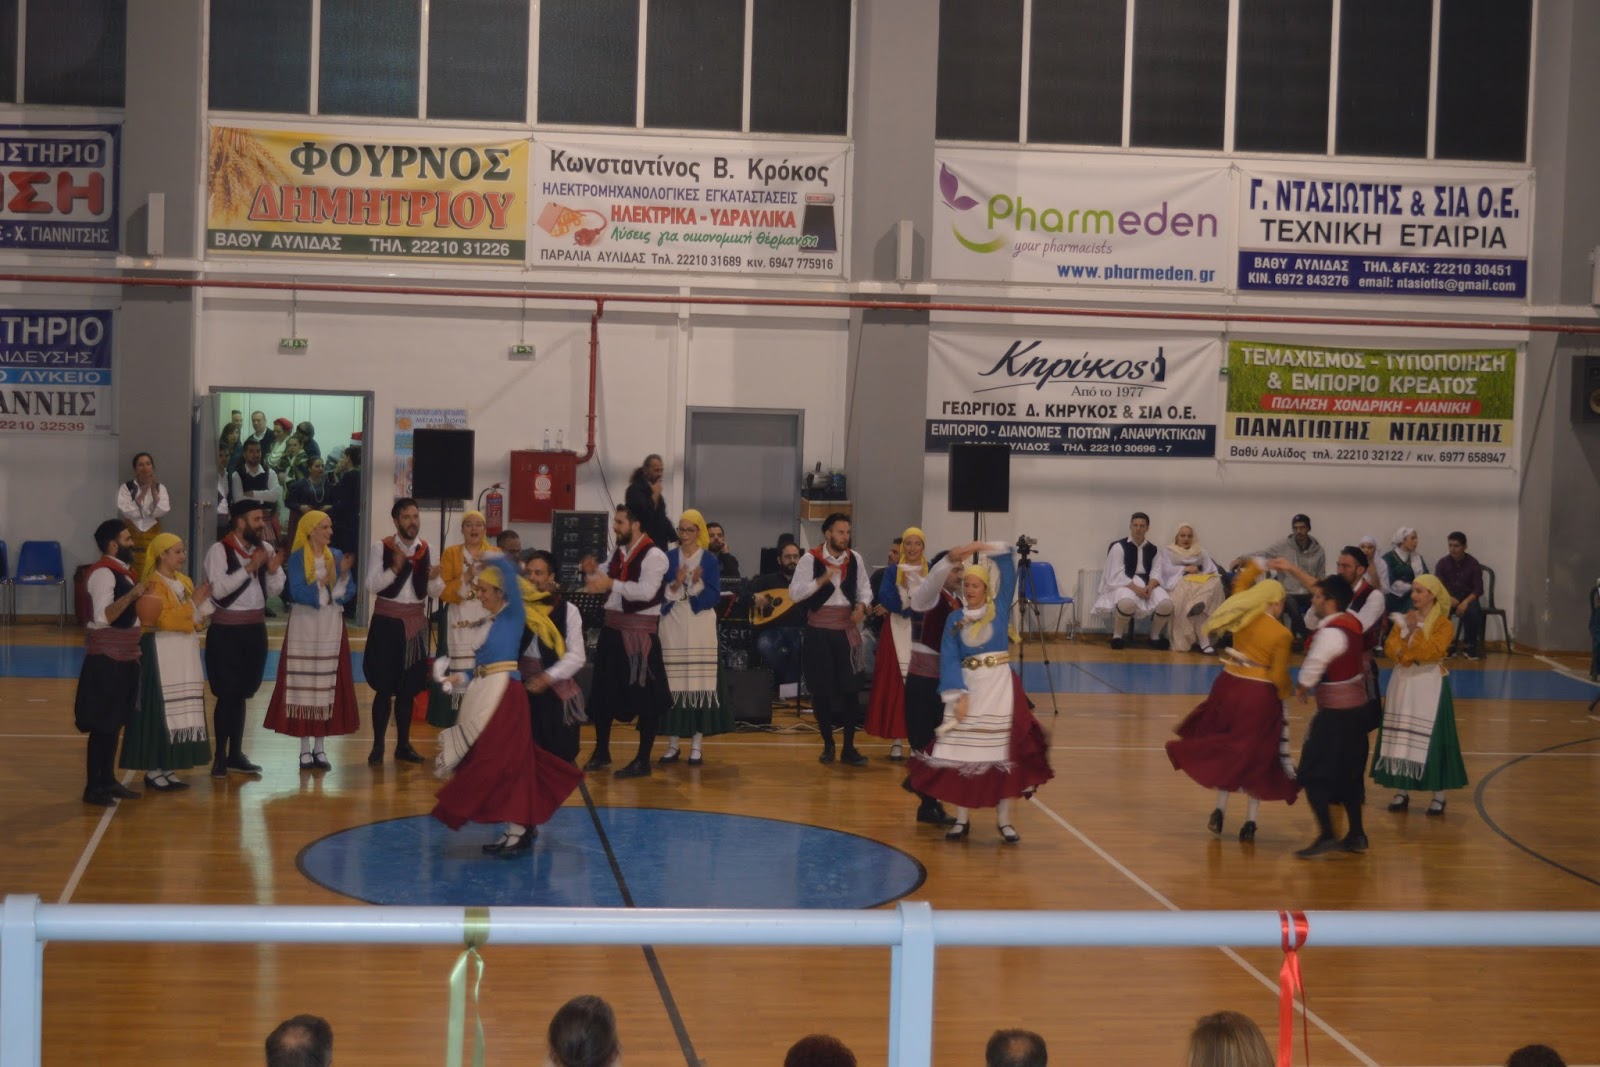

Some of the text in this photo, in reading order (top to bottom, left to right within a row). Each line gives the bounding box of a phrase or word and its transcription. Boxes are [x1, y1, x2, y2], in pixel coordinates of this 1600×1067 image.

[290, 141, 512, 181] ΦΟΥΡΝΟΣ
[550, 149, 829, 186] Κωνσταντίνος Β. Κρόκος
[0, 171, 104, 215] ΣΗ
[542, 182, 700, 201] ΗΛΕΚΤΡΟΜΗΧΑΝΟΛΟΓΙΚΕΣ
[706, 188, 798, 204] ΕΓΚΑΤΑΣΤΑΣΕΙΣ
[1250, 178, 1519, 218] Γ. ΝΤΑΣΙΩΤΗΣ & ΣΙΑ Ο.Ε.
[248, 184, 515, 230] ΔΗΜΗΤΡΙΟΥ
[611, 204, 697, 225] ΗΛΕΚΤΡΙΚΑ
[711, 208, 796, 228] ΥΔΡΑΥΛΙΚΑ
[15, 226, 27, 242] Χ.
[31, 226, 110, 243] ΓΙΑΝΝΙΤΣΗΣ
[215, 232, 510, 256] ΒΑΘΥ ΑΥΛΙΔΑΣ ΤΗΛ. 22210 31226
[610, 226, 651, 244] Λύσεις
[657, 229, 679, 246] για
[683, 230, 752, 252] οικονομική
[1260, 219, 1507, 249] ΤΕΧΝΙΚΗ ΕΤΑΙΡΙΑ
[540, 249, 833, 270] ΠΑΡΑΛΙΑ ΑΥΛΙΔΑΣ Τηλ. 22210 31689 κιν. 6947 775916
[1012, 239, 1112, 258] your pharmacists
[1254, 257, 1288, 269] ΒΑΘΥ
[1294, 259, 1349, 272] ΑΥΛΙΔΑΣ
[1433, 263, 1471, 275] 22210
[1474, 264, 1512, 276] 30451
[1248, 272, 1516, 292] ΚΙΝ. 6972 843276 email: ntasiotis@gmail.com
[0, 316, 104, 346] ΤΗΡΙΟ
[977, 340, 1146, 391] Κηρύκος
[1240, 347, 1365, 369] ΤΕΜΑΧΙΣΜΟΣ
[1386, 353, 1506, 372] ΤΥΠΟΠΟΙΗΣΗ
[21, 371, 101, 383] ΛΥΚΕΙΟ
[1267, 372, 1477, 395] & ΕΜΠΟΡΙΟ ΚΡΕΑΤΟΣ
[1070, 384, 1144, 398] Από το 1977
[942, 401, 1196, 420] ΓΕΩΡΓΙΟΣ Δ. ΚΗΡΥΚΟΣ & ΣΙΑ Ο.Ε.
[1271, 397, 1328, 410] ΠΩΛΗΣΗ
[1333, 399, 1403, 413] ΧΟΝΔΡΙΚΗ
[1414, 402, 1471, 414] ΛΙΑΝΙΚΗ
[40, 422, 85, 431] 32539
[931, 423, 988, 437] ΕΜΠΟΡΙΟ
[998, 425, 1061, 439] ΔΙΑΝΟΜΕΣ
[1067, 426, 1110, 439] ΠΟΤΩΝ
[1120, 427, 1206, 441] ΑΝΑΨΥΚΤΙΚΩΝ
[1235, 417, 1502, 443] ΠΑΝΑΓΙΩΤΗΣ ΝΤΑΣΙΩΤΗΣ
[1004, 442, 1050, 451] ΥΛΙΔΟΣ
[1062, 443, 1087, 452] ΤΗΛ.
[1090, 443, 1121, 453] 22210
[1124, 444, 1156, 453] 30696
[1165, 444, 1172, 453] 7
[1230, 446, 1258, 457] Βαθύ
[1261, 447, 1306, 460] Αυλίδος
[1312, 450, 1333, 461] τηλ.
[1337, 449, 1369, 461] 22210
[1371, 450, 1403, 461] 32122
[1417, 453, 1436, 463] κιν.
[1439, 452, 1466, 463] 6977
[1468, 453, 1506, 463] 658947
